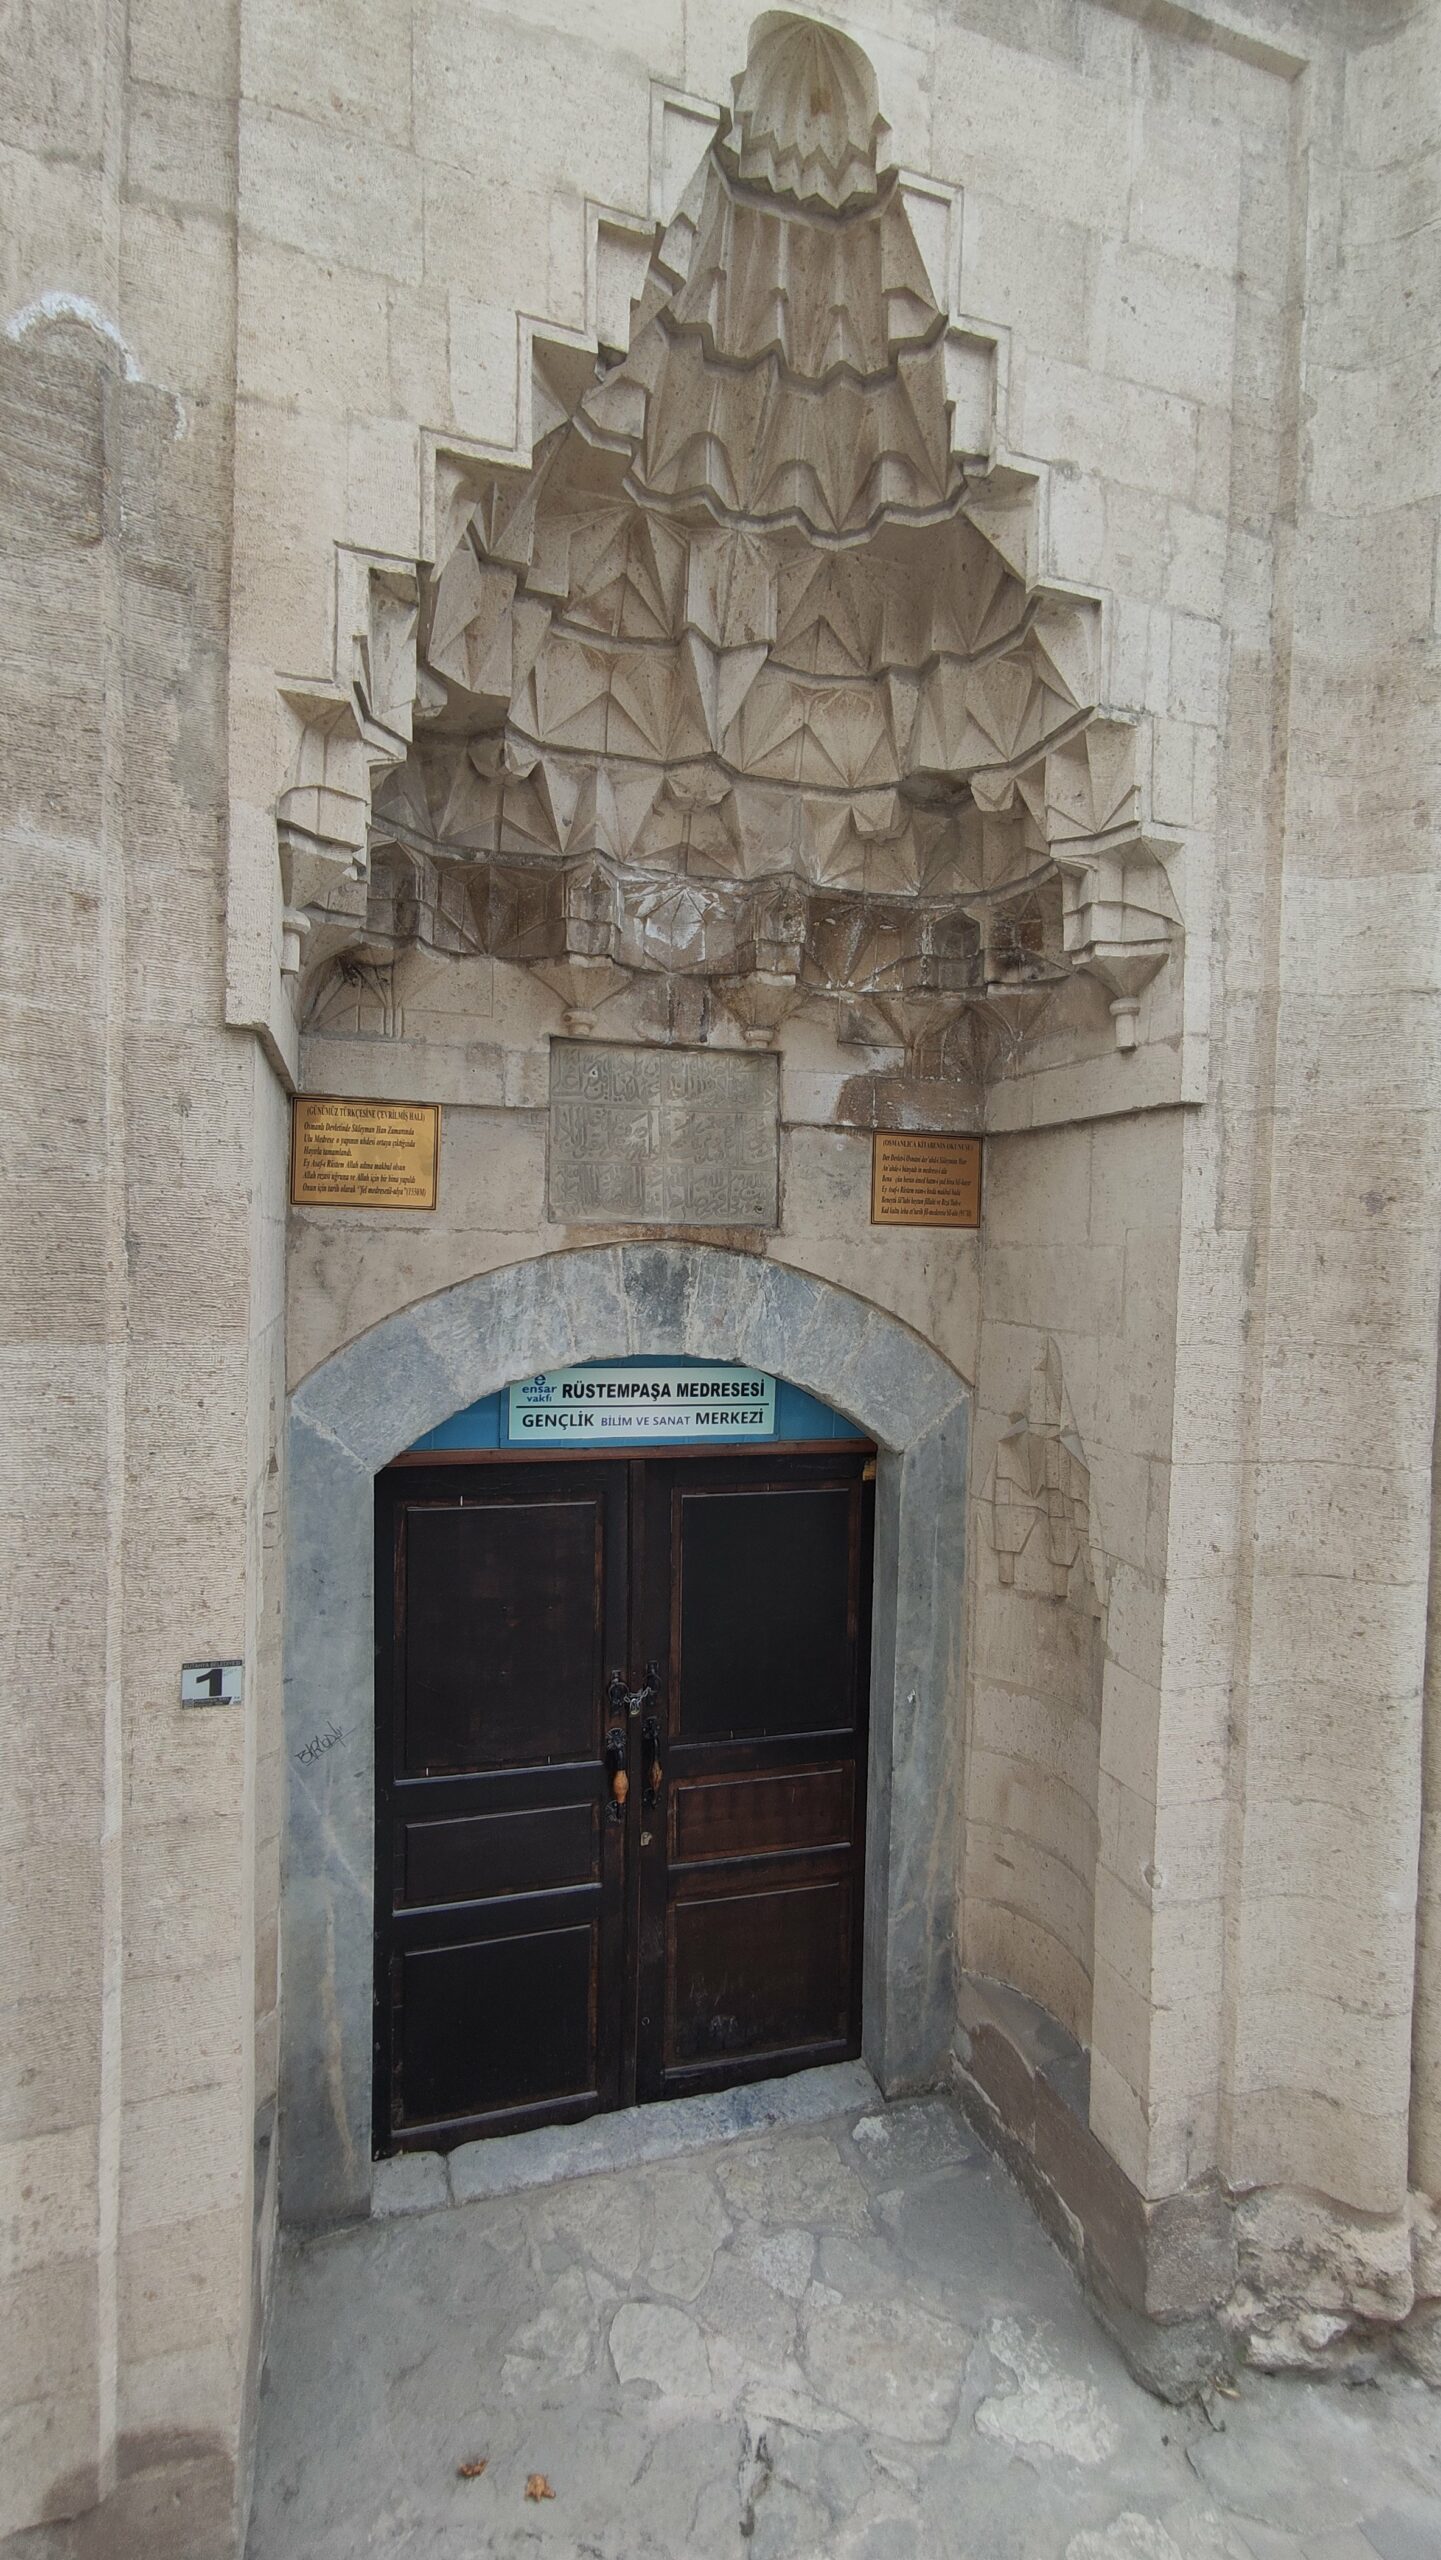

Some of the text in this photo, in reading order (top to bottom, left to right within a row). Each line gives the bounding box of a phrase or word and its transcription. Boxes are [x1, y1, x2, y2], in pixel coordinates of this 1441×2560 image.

[306, 1104, 339, 1117] (GÜNÜMÜZ
[340, 1105, 376, 1119] TÜRKÇESİNE
[376, 1108, 408, 1121] ÇEVRİLMİŞ
[303, 1122, 325, 1130] Osmanlı
[326, 1123, 351, 1131] Devletinde
[351, 1124, 375, 1135] Süleyman
[314, 1133, 335, 1143] Medrese
[326, 1159, 345, 1168] Rüstem
[346, 1160, 359, 1168] Allah
[303, 1170, 317, 1179] Allah
[357, 1172, 369, 1181] Allah
[521, 1386, 557, 1394] ensar
[562, 1378, 765, 1402] RÜSTEMPAŞA MEDRESESİ
[522, 1407, 764, 1431] GENÇLİK BİLİM VE SANAT MERKEZİ
[196, 1668, 223, 1697] 1
